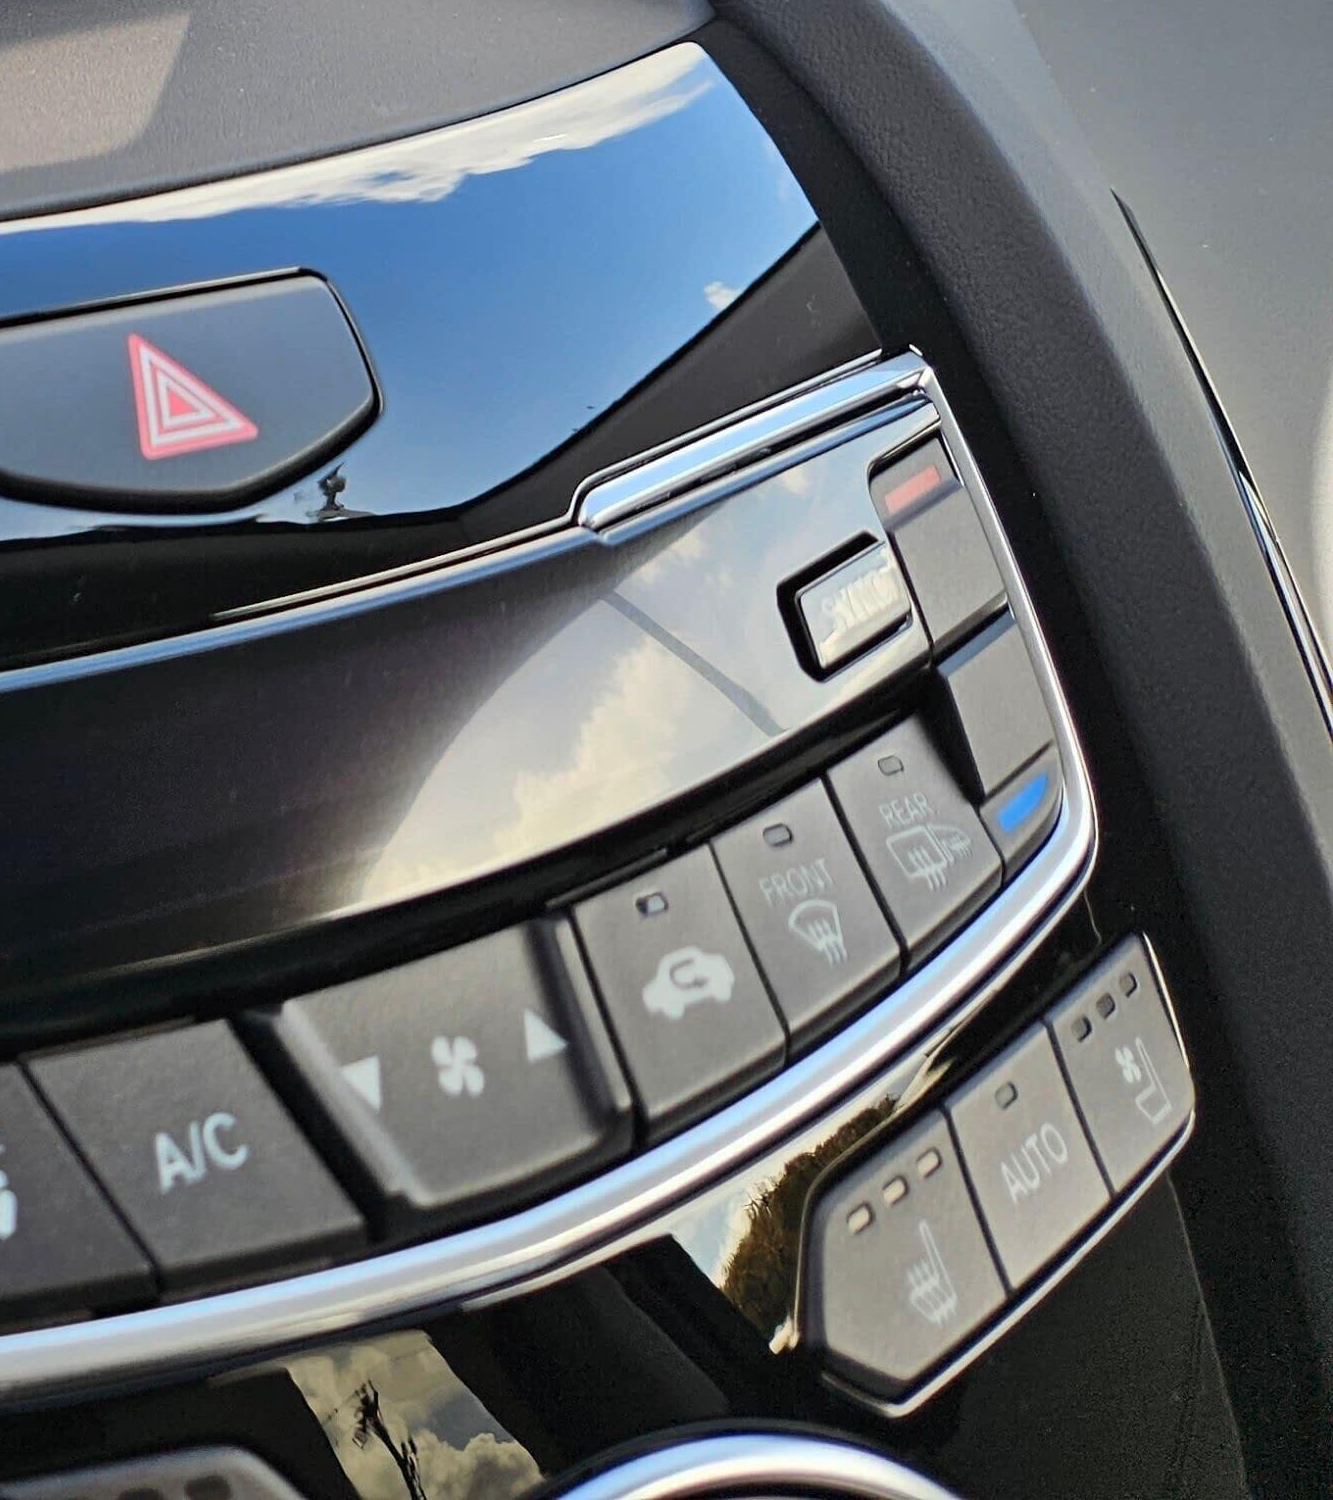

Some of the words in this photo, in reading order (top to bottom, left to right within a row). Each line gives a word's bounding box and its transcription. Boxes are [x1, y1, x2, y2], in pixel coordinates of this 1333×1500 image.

[878, 791, 934, 828] REAR
[758, 857, 834, 907] FRONT
[153, 1112, 250, 1194] A/C
[1000, 1122, 1069, 1204] AUTO
